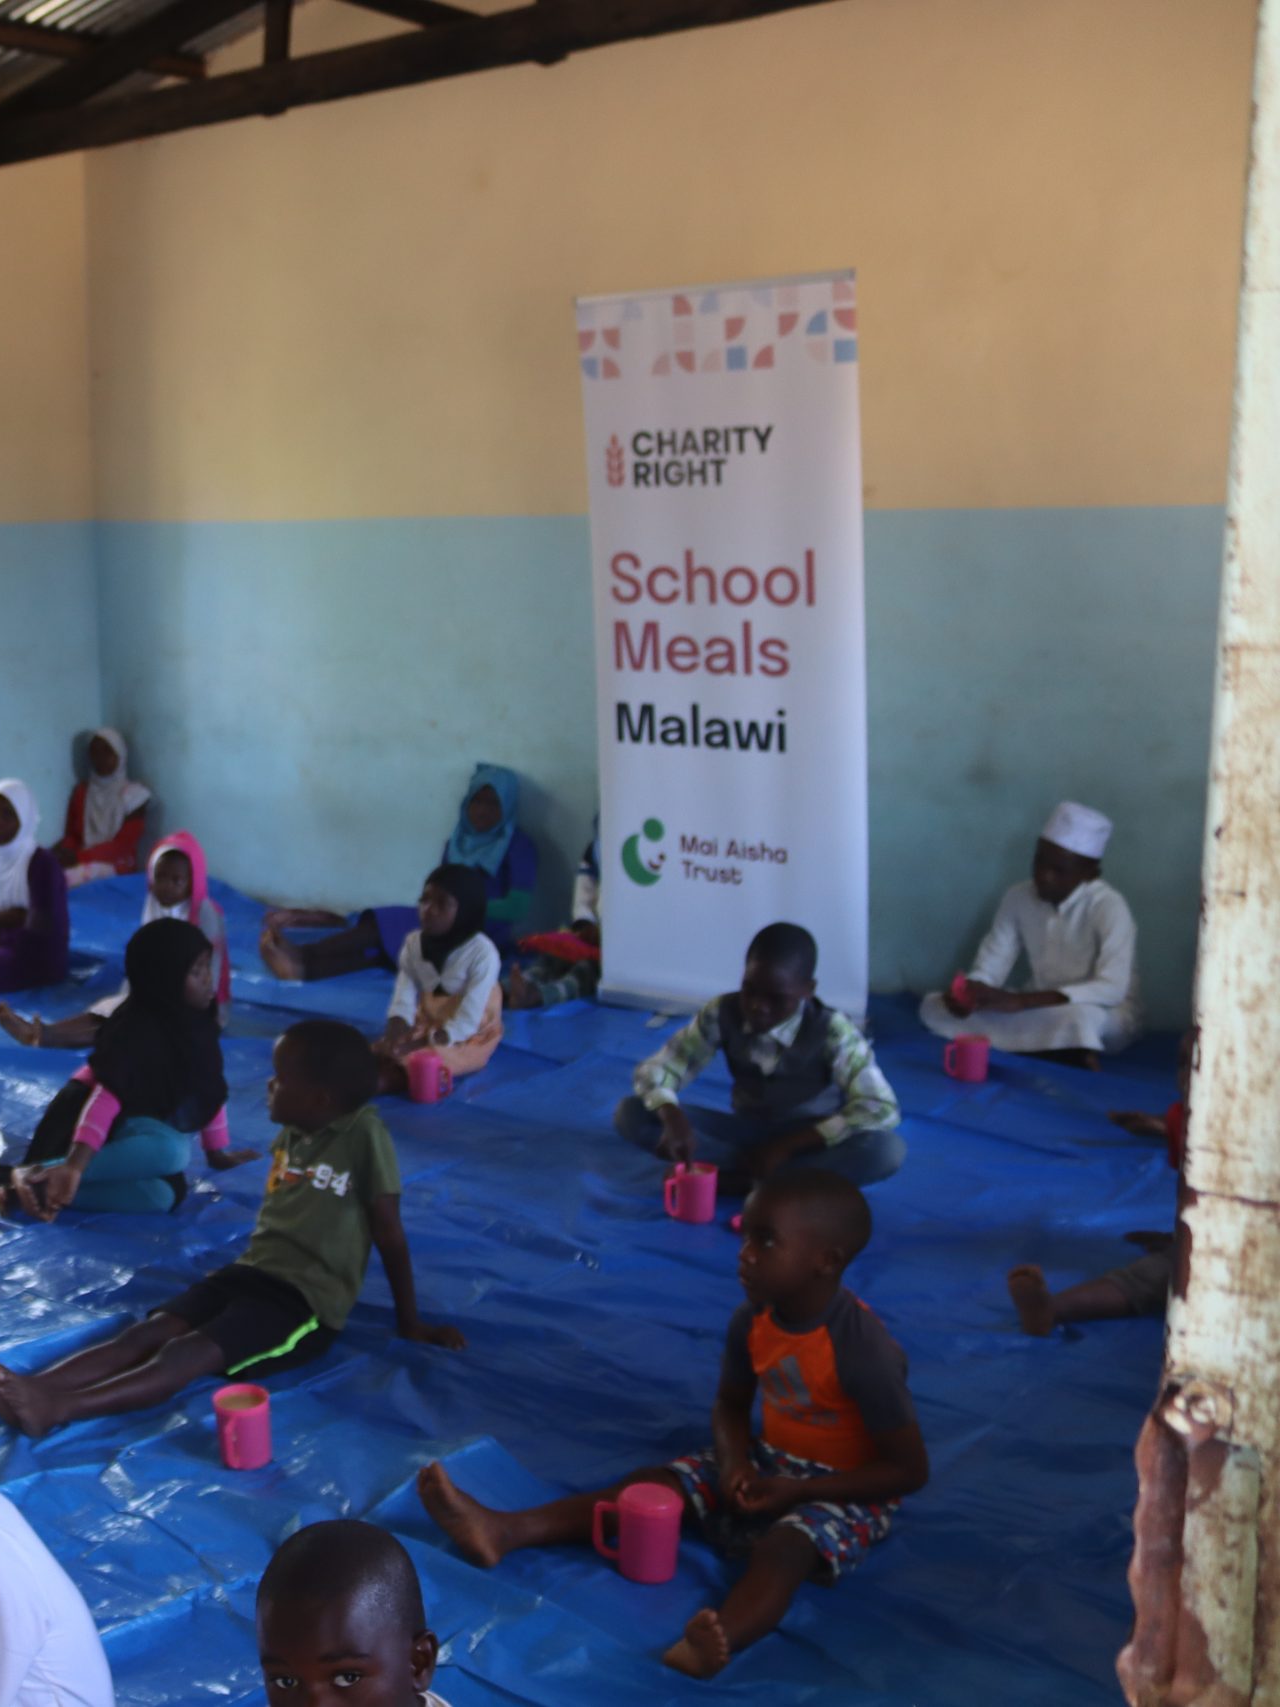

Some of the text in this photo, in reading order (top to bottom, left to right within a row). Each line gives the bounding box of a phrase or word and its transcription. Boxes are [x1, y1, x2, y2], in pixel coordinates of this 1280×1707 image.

[631, 425, 773, 457] CHARITY
[632, 459, 727, 487] RIGHT
[610, 548, 816, 606] School
[613, 620, 790, 677] Meals
[616, 702, 787, 753] Malawi
[680, 834, 788, 864] Mai Aisha
[681, 860, 743, 885] Trust
